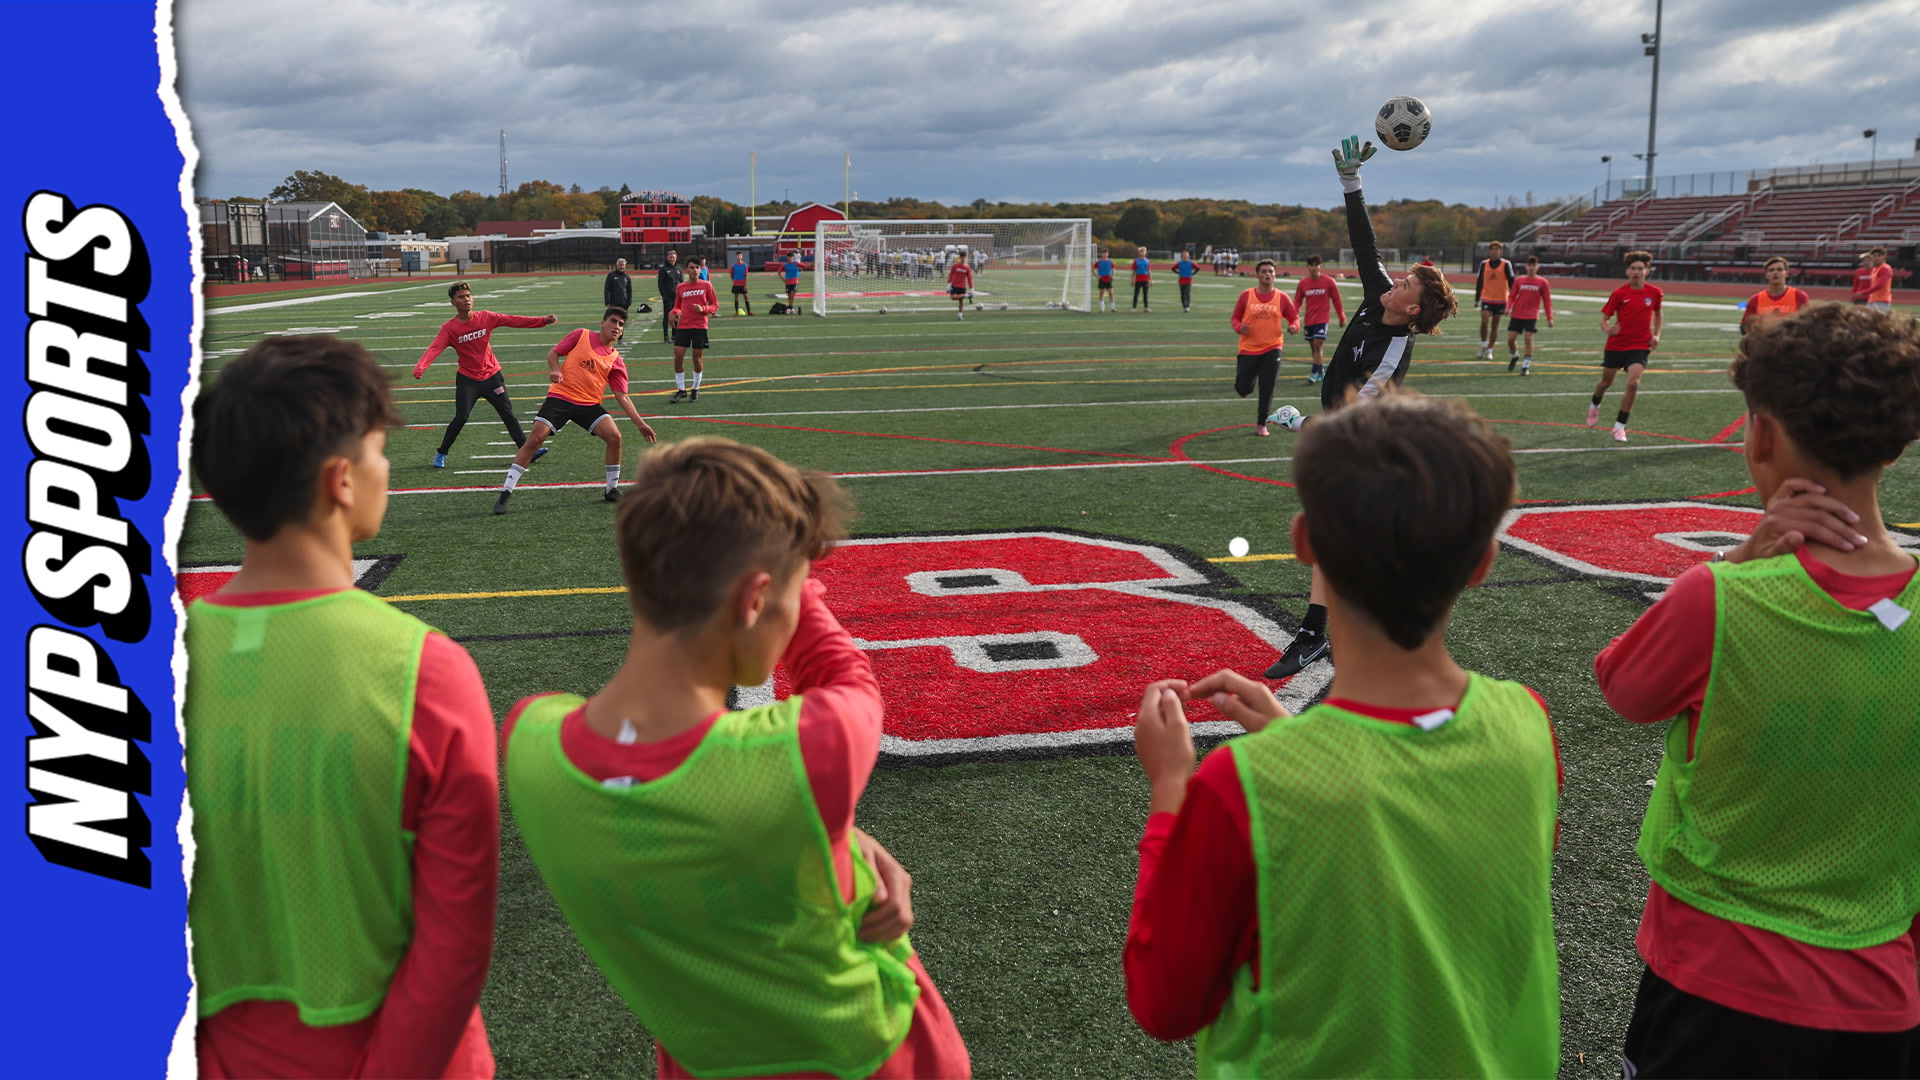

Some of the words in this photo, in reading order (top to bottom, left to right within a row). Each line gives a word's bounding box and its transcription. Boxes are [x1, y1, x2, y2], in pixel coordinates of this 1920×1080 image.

[682, 289, 705, 298] SOCCER
[1249, 303, 1278, 312] SOCCER
[457, 328, 487, 344] SOCCER
